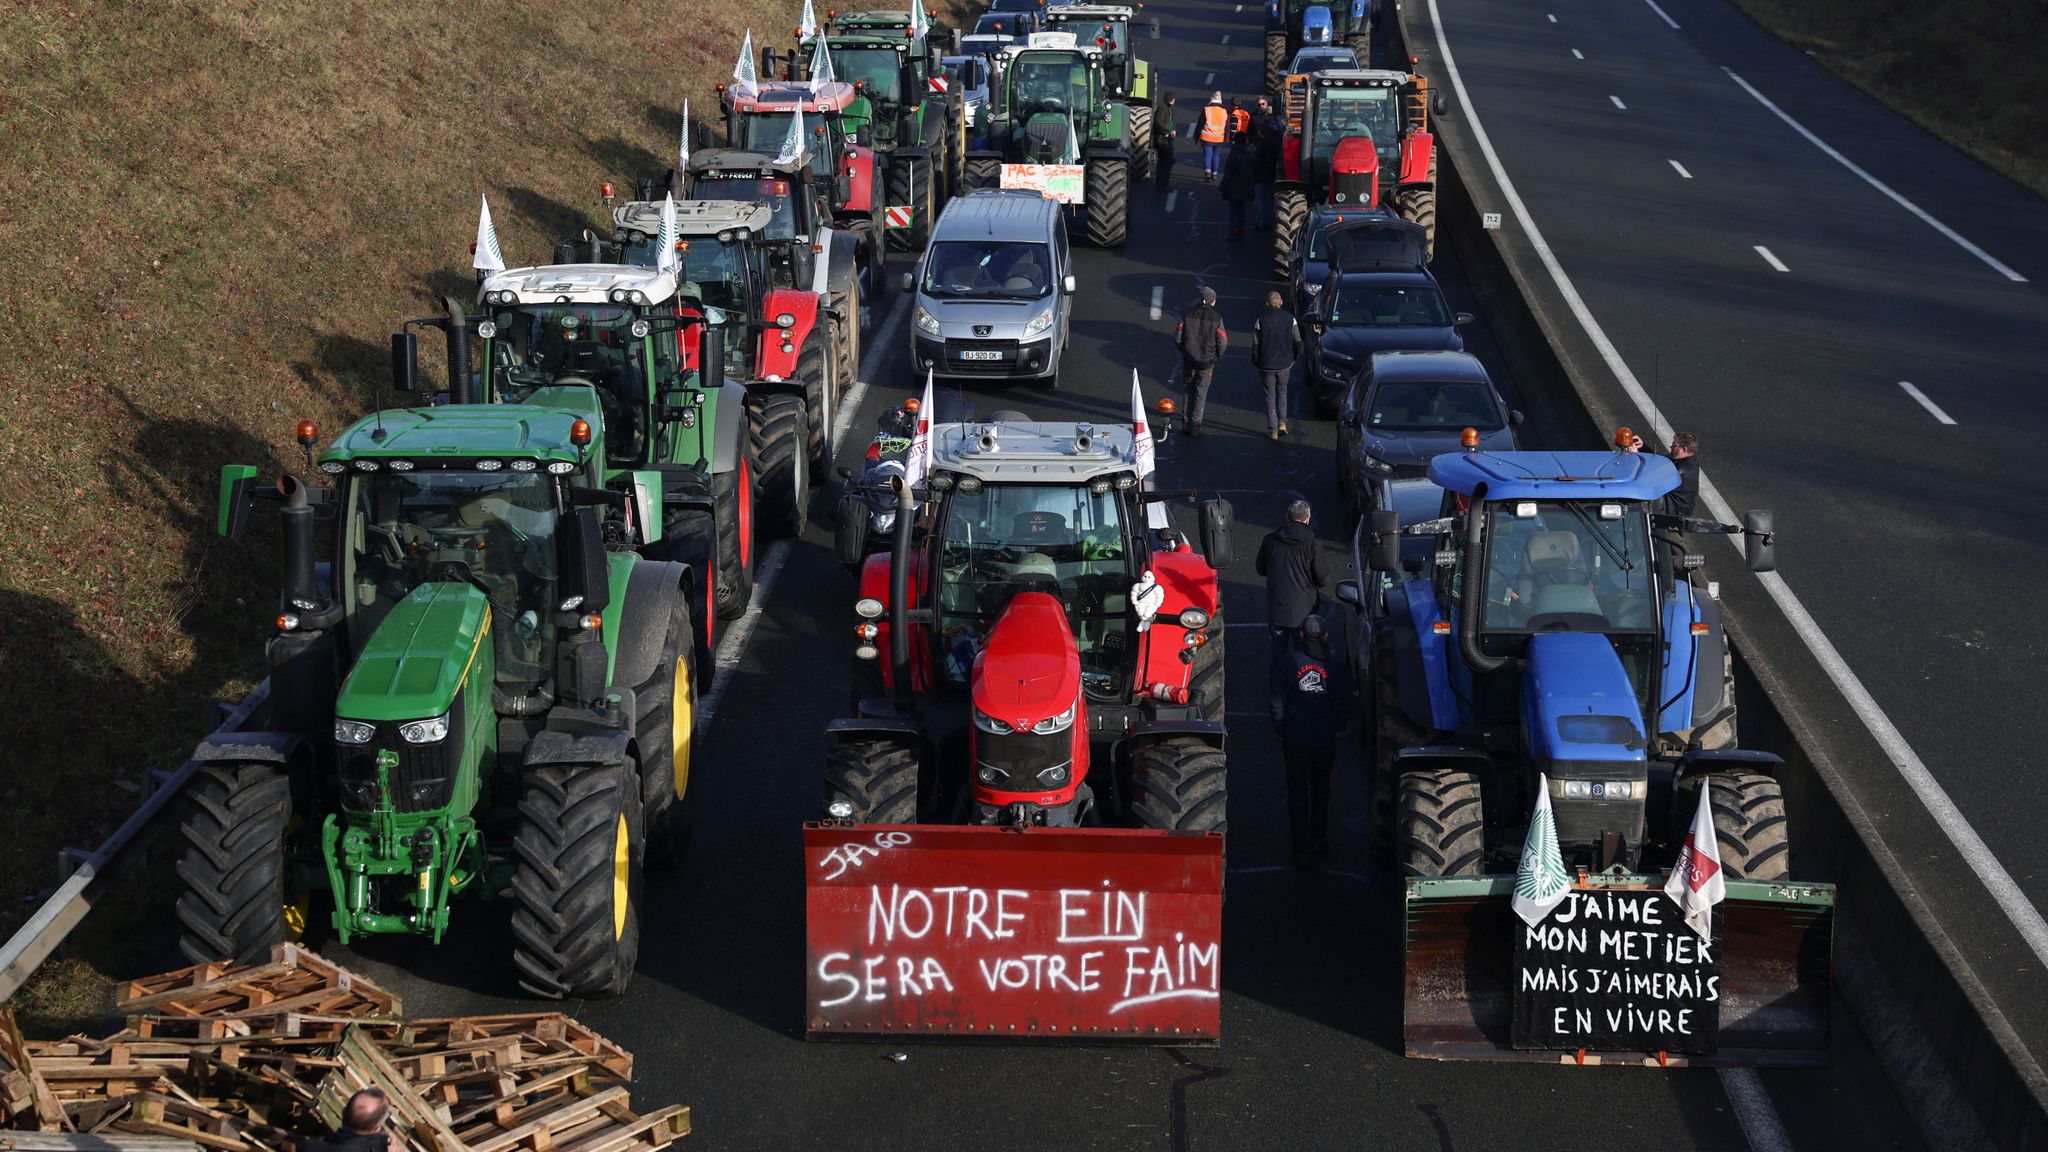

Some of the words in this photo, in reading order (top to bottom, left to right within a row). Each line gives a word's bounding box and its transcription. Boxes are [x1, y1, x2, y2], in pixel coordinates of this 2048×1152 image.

[1007, 164, 1036, 177] PAC
[869, 884, 1029, 944] NOTRE
[1555, 891, 1663, 925] J'AIME
[1526, 924, 1587, 953] MON
[818, 952, 954, 1007] SERA
[979, 951, 1104, 992] VOTRE
[1123, 932, 1219, 998] FAIM
[1522, 964, 1579, 993] MAIS
[1585, 968, 1720, 1002] J'AIMERAIS
[1554, 1007, 1592, 1034] EN
[1606, 1003, 1693, 1035] VIVRE
